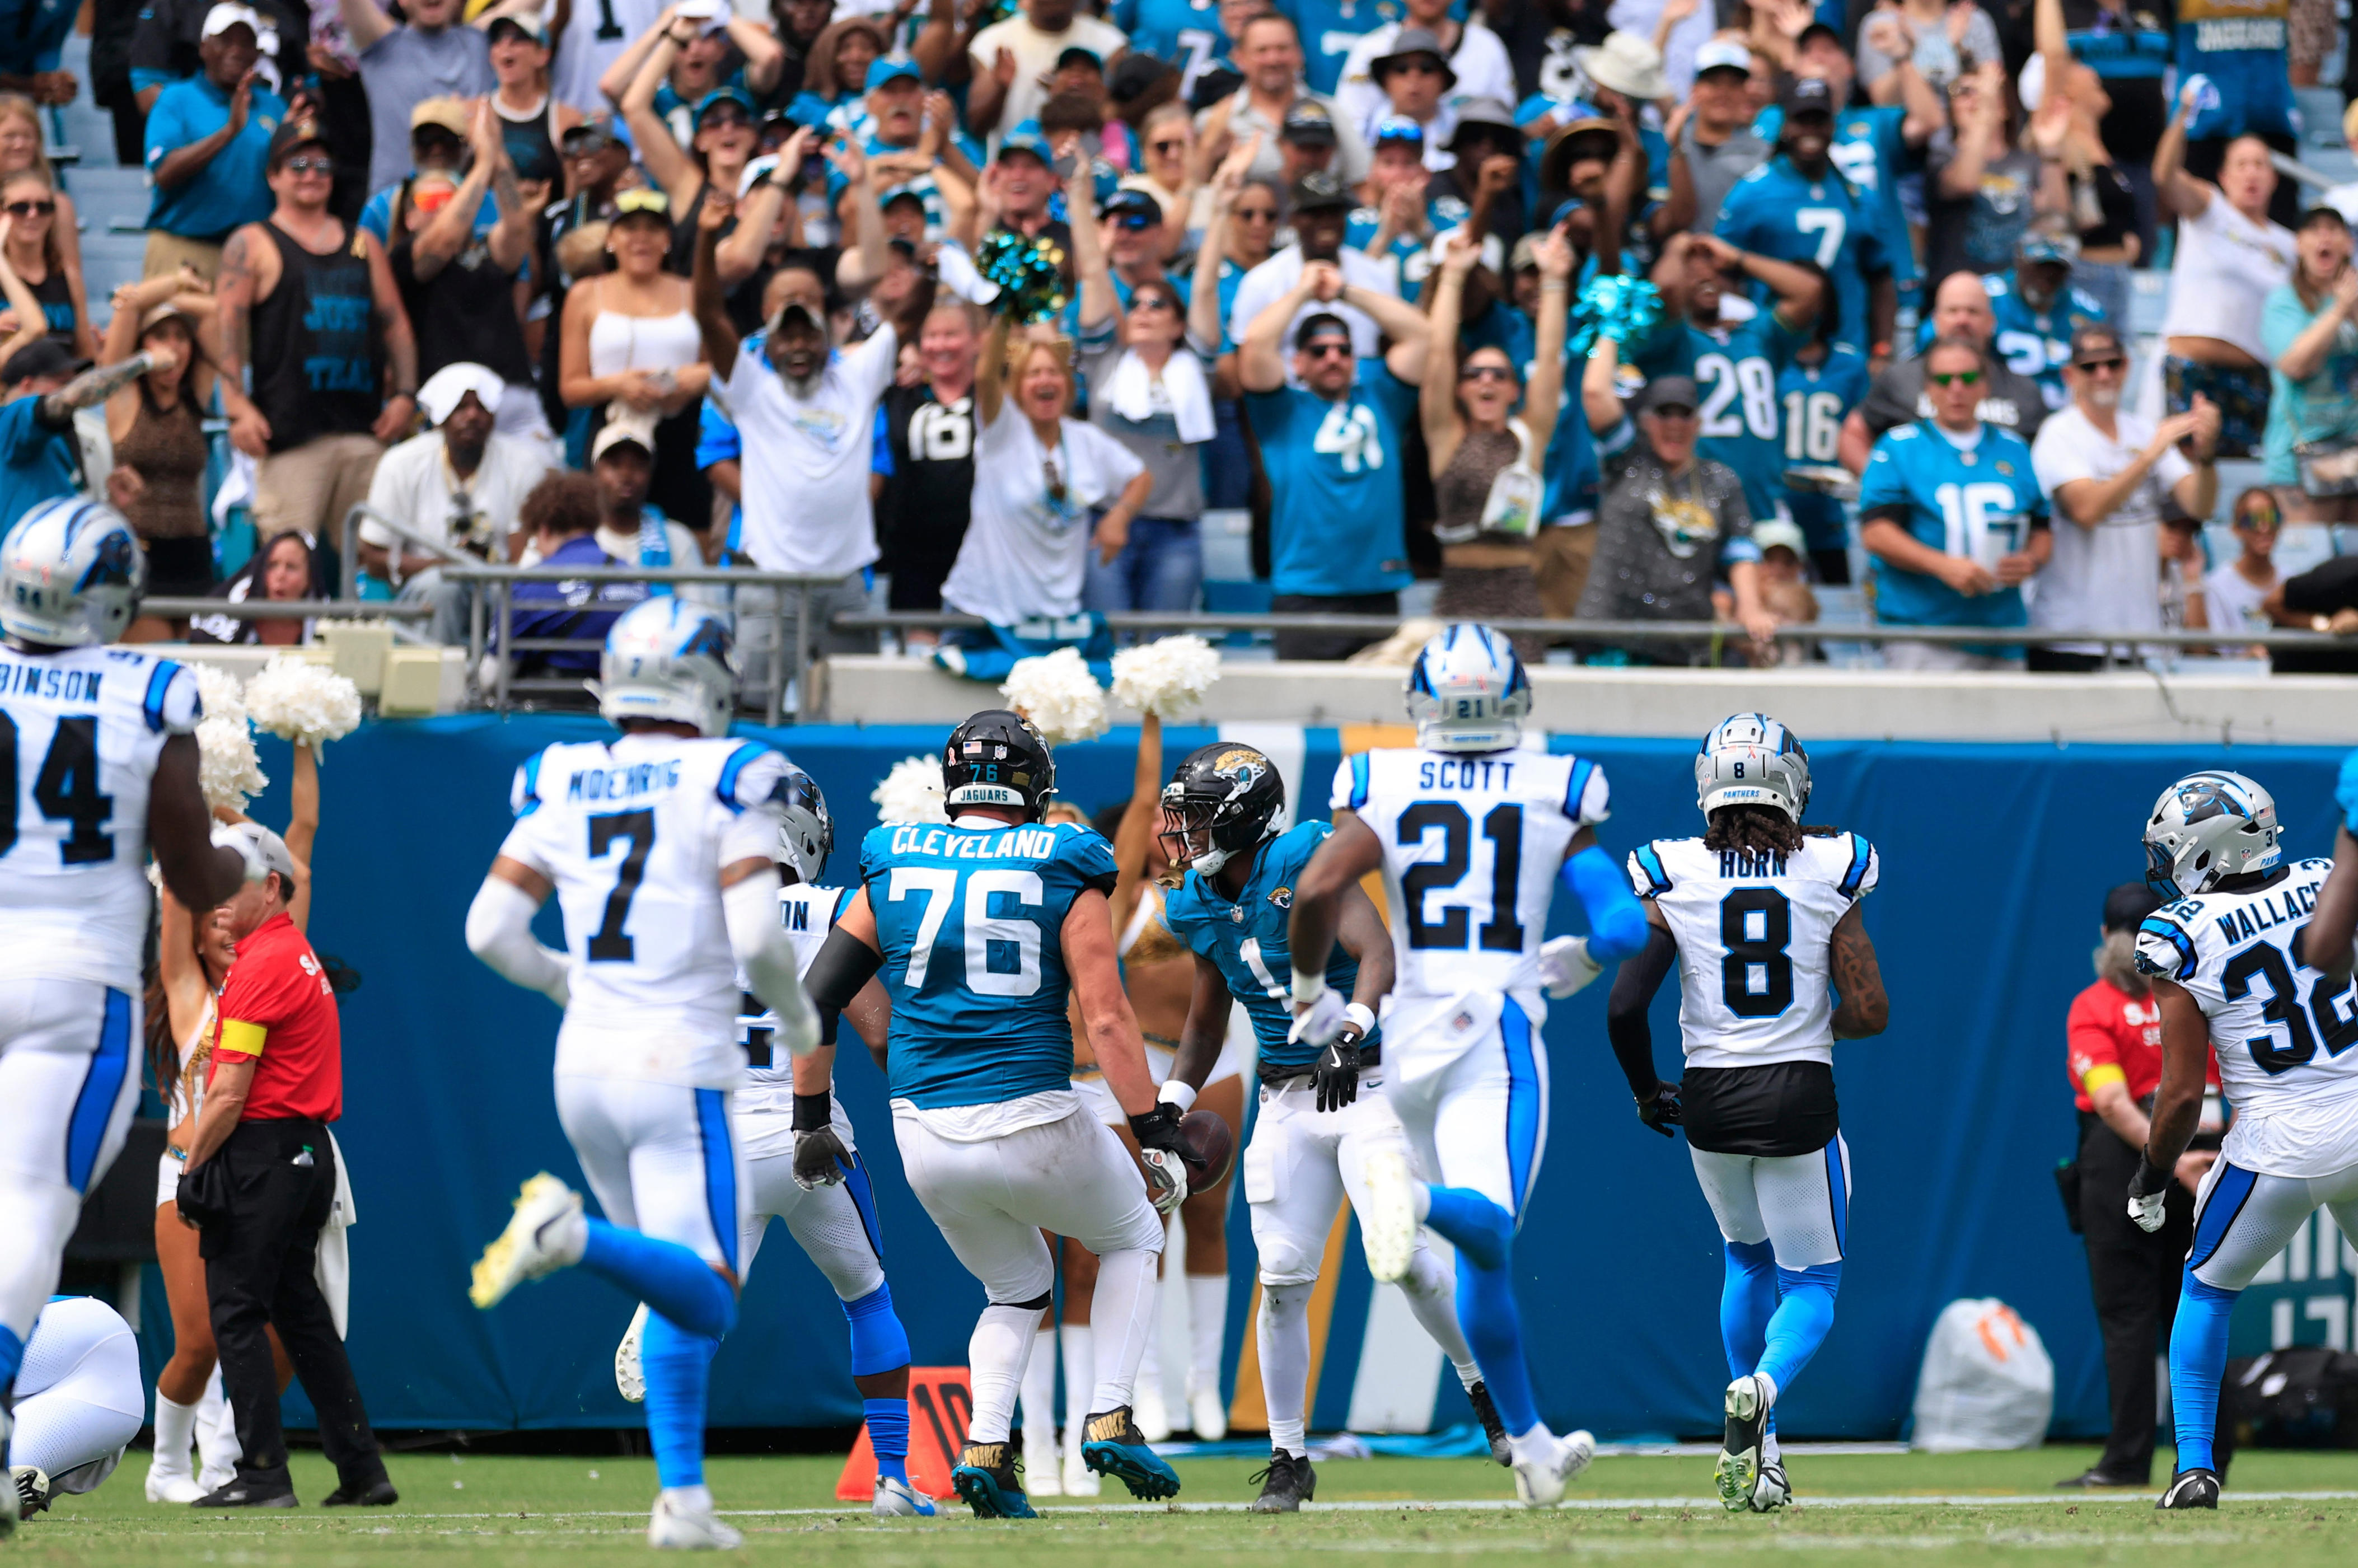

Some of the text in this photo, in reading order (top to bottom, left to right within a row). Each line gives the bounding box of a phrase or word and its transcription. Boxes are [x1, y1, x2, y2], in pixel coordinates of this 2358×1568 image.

[1796, 208, 1846, 270] 7
[1695, 353, 1778, 440] 28
[1784, 390, 1842, 461] 16
[1458, 699, 1482, 719] 21
[0, 708, 115, 865] 4
[970, 764, 998, 782] 76
[1419, 761, 1515, 792] SCOTT
[1734, 762, 1744, 779] 8
[960, 789, 1008, 802] JAGUARS
[1723, 789, 1760, 799] PANTHERS
[891, 825, 1056, 860] CLEVELAND
[1397, 800, 1524, 953] 21
[1719, 850, 1788, 879] HORN
[587, 809, 656, 964] 7
[888, 867, 1044, 997] 76
[1720, 886, 1795, 1019] 8
[1088, 1411, 1126, 1443] NIKE
[964, 1445, 1005, 1468] NIKE
